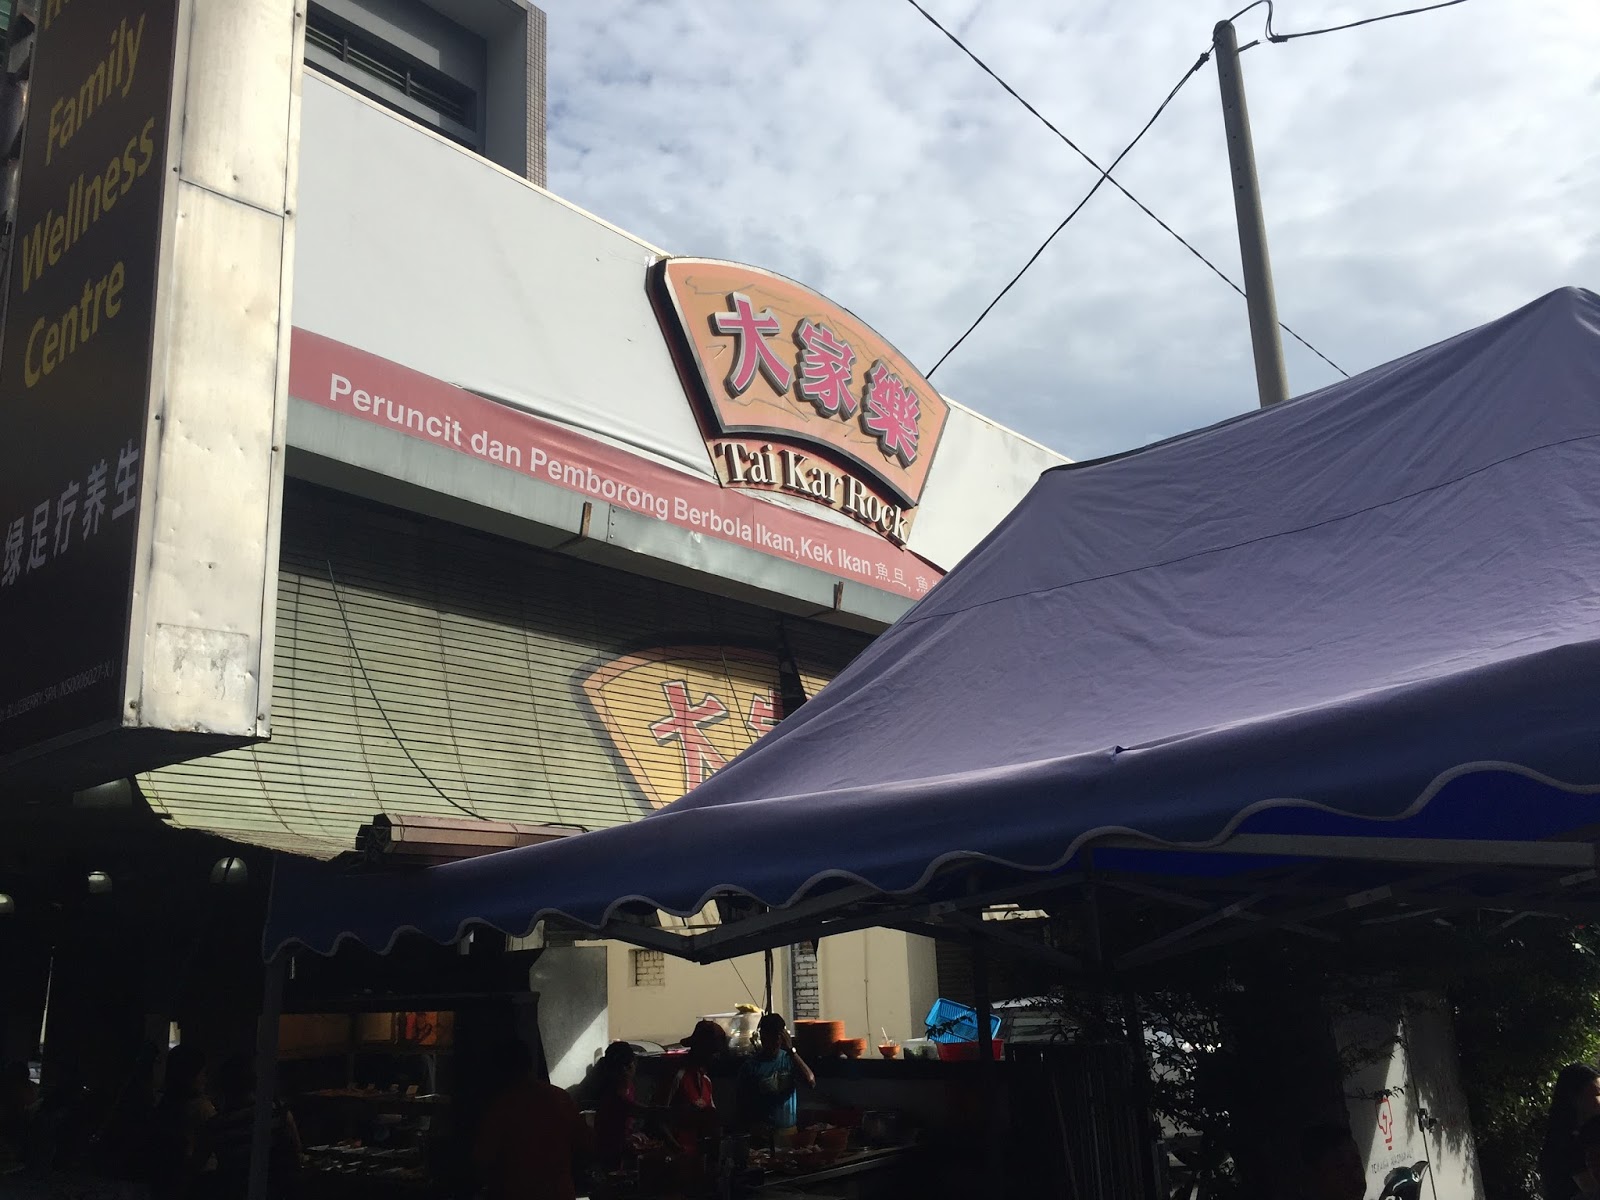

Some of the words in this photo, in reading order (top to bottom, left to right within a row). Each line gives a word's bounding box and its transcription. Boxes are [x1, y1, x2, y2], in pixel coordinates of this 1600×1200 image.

[45, 12, 146, 167] Family
[23, 117, 155, 293] Wellness
[24, 261, 125, 389] Centre
[707, 291, 922, 468] 大家樂
[329, 373, 463, 447] Peruncit
[470, 430, 522, 467] dan
[529, 446, 669, 520] Pemborong
[673, 496, 752, 543] Berbola
[837, 547, 872, 577] Ikan
[717, 441, 776, 485] Tai
[782, 448, 845, 503] Kar
[845, 474, 908, 546] Rock
